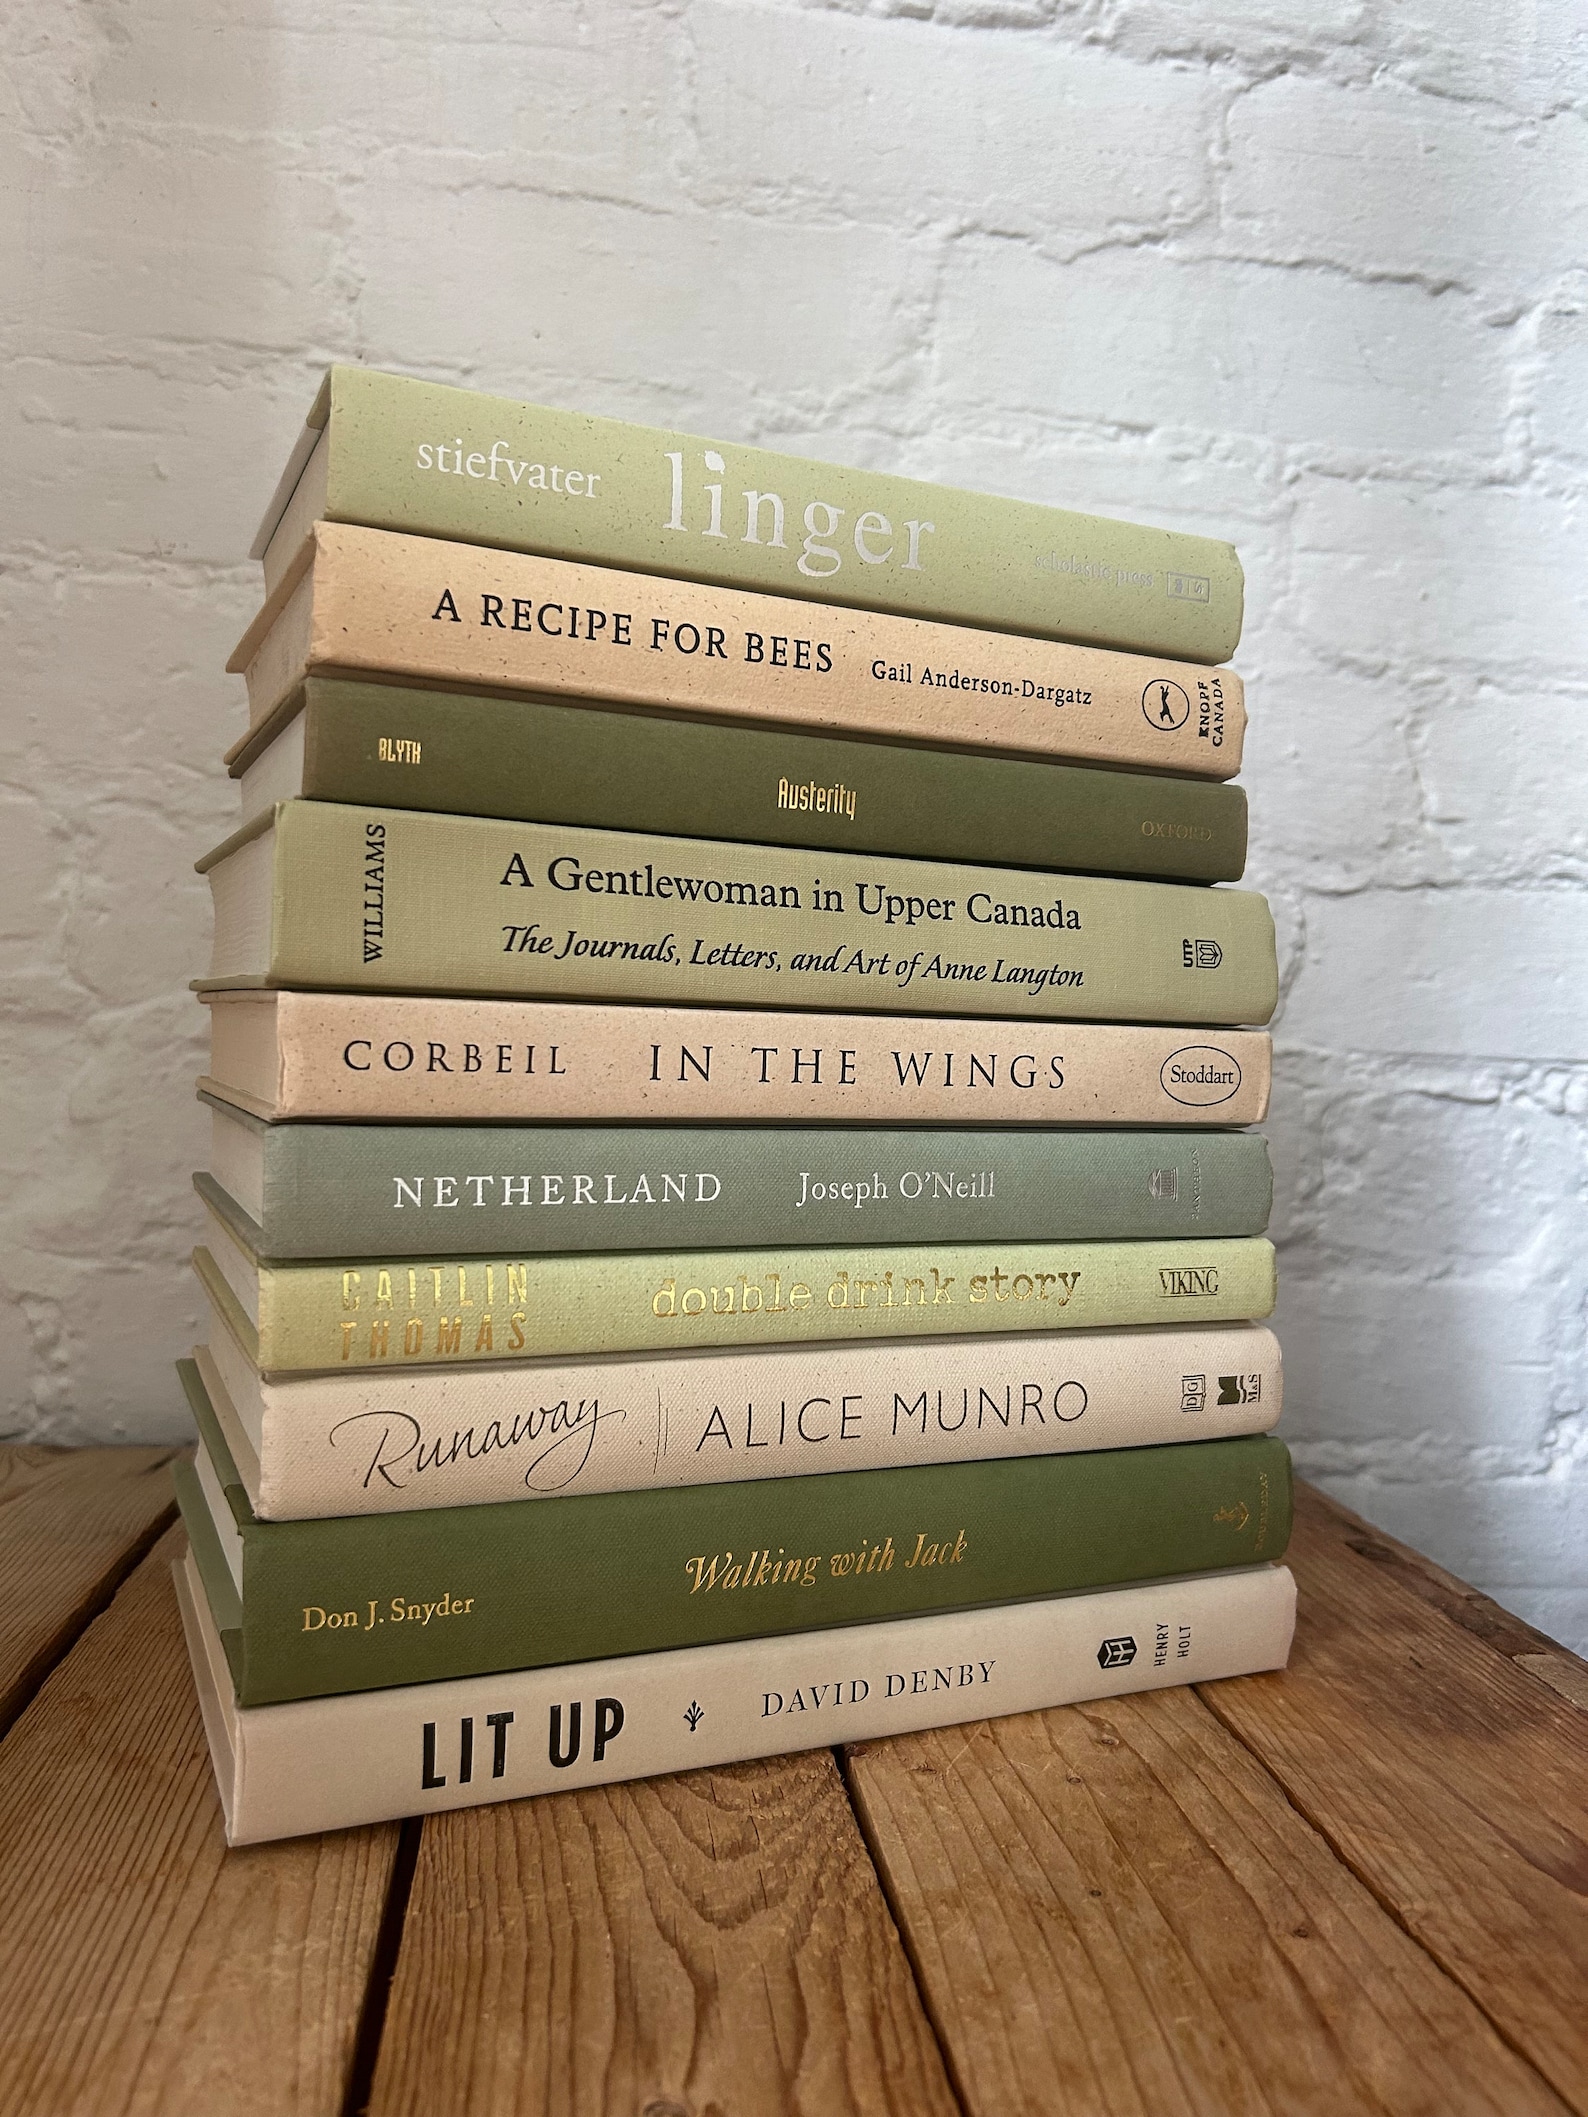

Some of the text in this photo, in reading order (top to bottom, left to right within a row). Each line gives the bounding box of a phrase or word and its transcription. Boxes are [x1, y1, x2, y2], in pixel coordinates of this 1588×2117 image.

[417, 438, 601, 498] stiefvater
[663, 450, 935, 578] linger
[1035, 551, 1154, 587] scholastic press
[432, 589, 832, 673] A RECIPE FOR BEES
[871, 660, 1092, 708] Gail Anderson-Dargatz
[1197, 682, 1210, 738] KNOPF
[1212, 678, 1224, 747] CANADA
[379, 738, 421, 764] BLYTH
[778, 776, 857, 821] Austerity
[1141, 820, 1212, 841] OXFORD
[363, 824, 386, 963] WILLIAMS
[500, 853, 1082, 930] A Gentlewoman in Upper Canada
[501, 925, 1084, 995] The Journals, Letters, and Art of Anne Langton
[1183, 938, 1193, 967] UTP
[343, 1040, 566, 1075] CORBEIL
[650, 1044, 1066, 1089] IN THE WINGS
[1170, 1064, 1235, 1085] Stoddart
[393, 1173, 722, 1208] NETHERLAND
[795, 1171, 995, 1208] Joseph O'Neill
[341, 1263, 528, 1312] CAITLIN
[651, 1266, 1081, 1318] double drink story
[1159, 1268, 1219, 1295] VIKING
[340, 1312, 528, 1361] THOMAS
[696, 1380, 1088, 1452] ALICE MUNRO
[330, 1399, 627, 1491] Runaway
[685, 1529, 969, 1596] Walking with Jack
[301, 1592, 475, 1632] Don J. Snyder
[1153, 1623, 1168, 1667] HENRY
[1177, 1626, 1191, 1658] HOLT
[761, 1659, 997, 1718] DAVID DENBY
[421, 1696, 626, 1790] LIT UP
